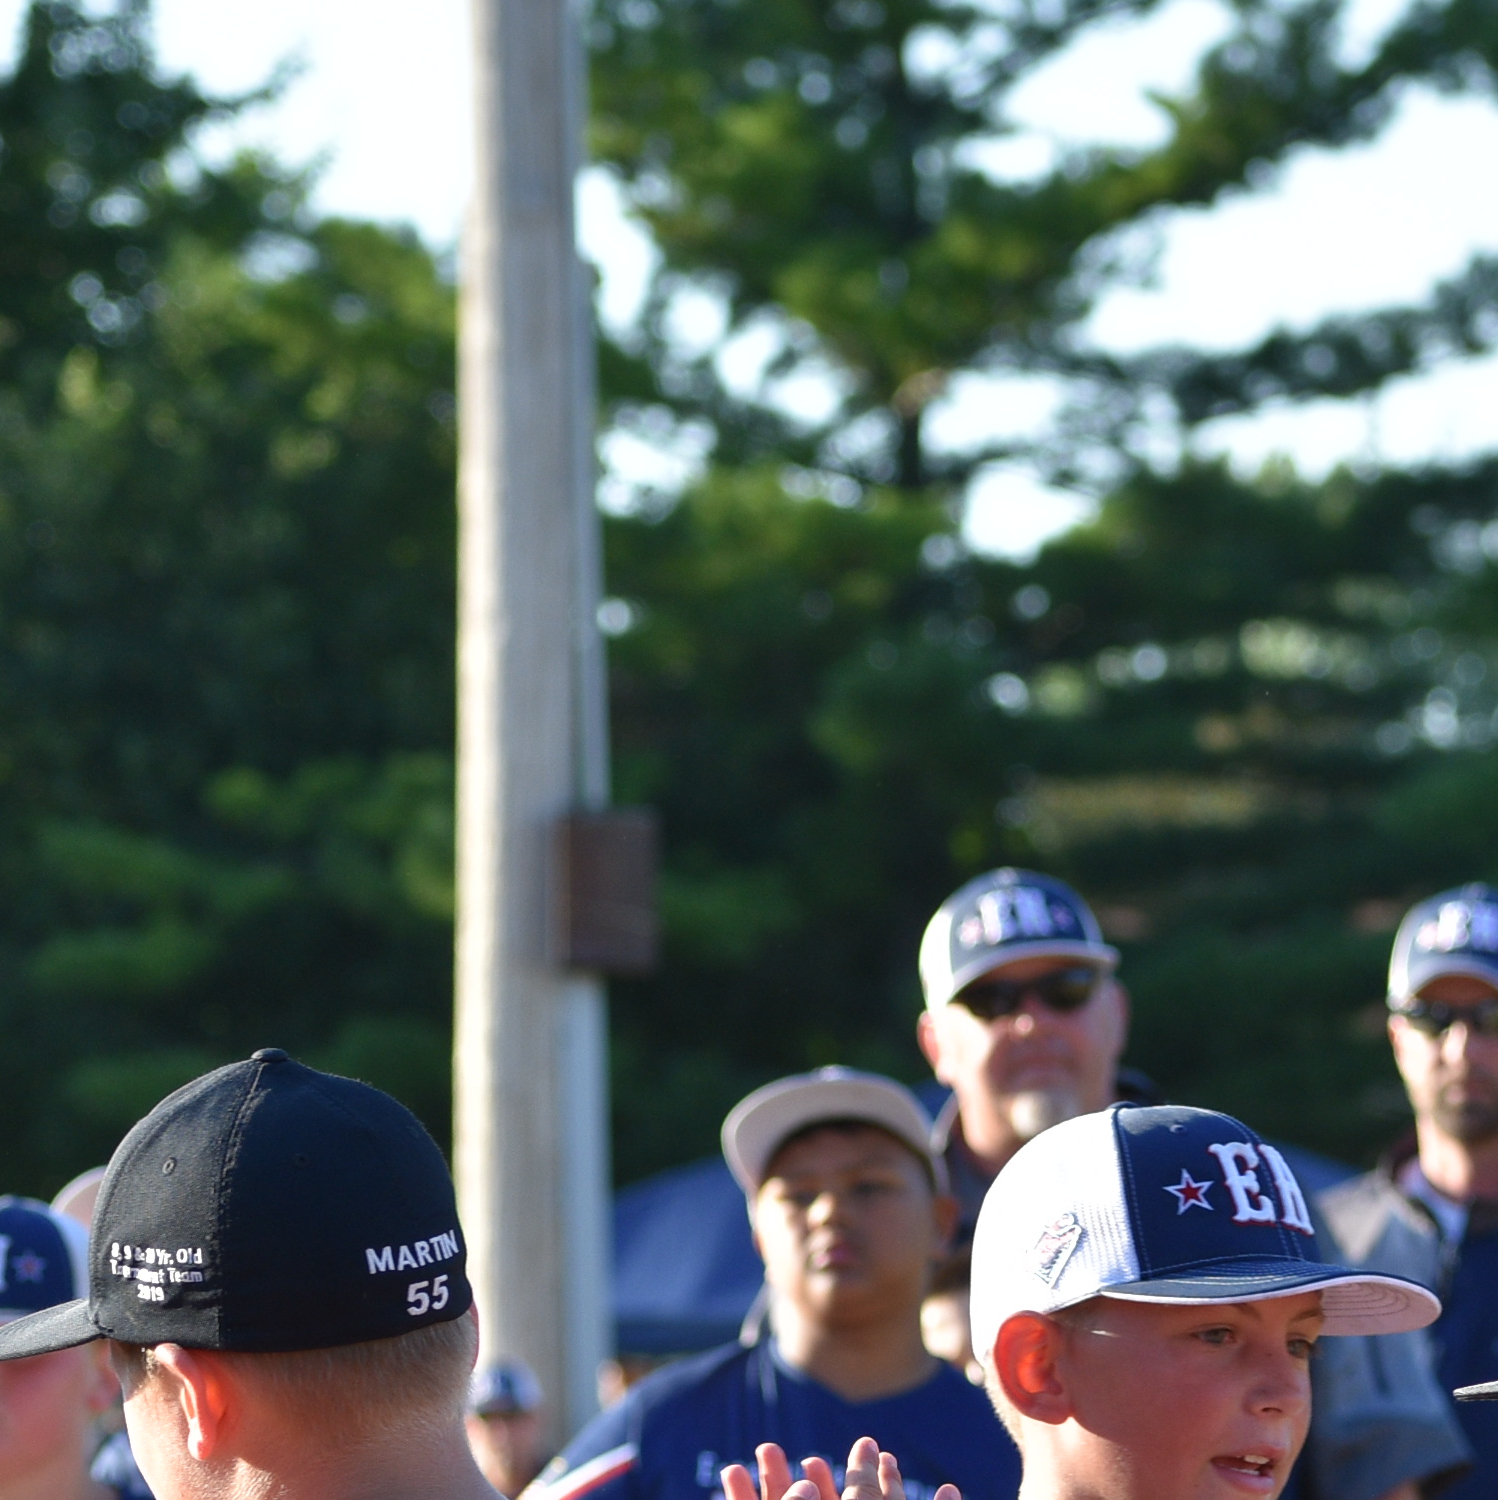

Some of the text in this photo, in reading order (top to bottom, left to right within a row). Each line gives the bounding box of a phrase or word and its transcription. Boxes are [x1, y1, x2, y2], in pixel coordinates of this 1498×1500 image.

[1208, 1141, 1315, 1237] EH
[365, 1229, 459, 1274] MARTIN
[406, 1274, 449, 1316] 55
